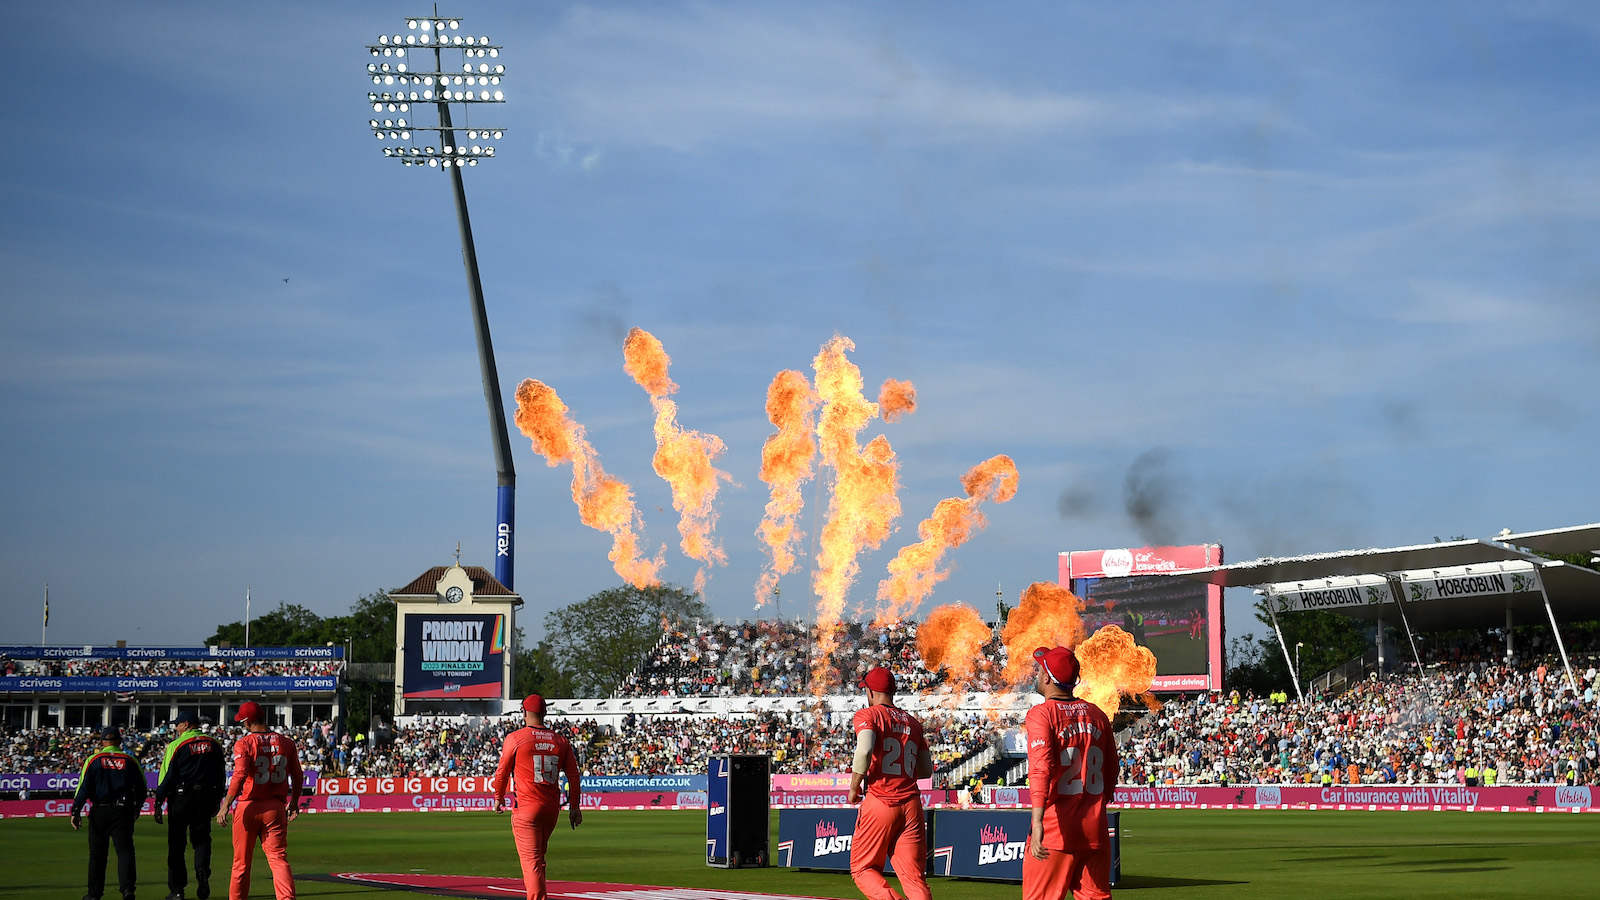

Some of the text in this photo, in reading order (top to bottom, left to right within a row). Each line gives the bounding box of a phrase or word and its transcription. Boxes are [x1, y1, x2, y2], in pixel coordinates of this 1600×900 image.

[498, 523, 510, 557] drax
[1434, 574, 1506, 597] HOBGOBLIN
[1299, 587, 1362, 608] HOBGOBLIN
[422, 621, 484, 640] PRIORITY
[44, 648, 84, 656] scrivens
[127, 648, 166, 657] scrivens
[217, 648, 255, 657] scrivens
[294, 648, 332, 657] scrivens
[422, 641, 484, 661] WINDOW
[19, 678, 62, 688] scrivens
[117, 678, 159, 688] scrivens
[202, 678, 242, 688] scrivens
[294, 678, 333, 688] scrivens
[1163, 678, 1180, 687] good
[1181, 678, 1204, 686] driving
[882, 737, 918, 778] 26
[254, 755, 288, 784] 33
[533, 755, 559, 784] 15
[1058, 746, 1104, 795] 28
[321, 779, 339, 794] IG
[349, 779, 367, 794] IG
[376, 778, 395, 793] IG
[404, 778, 422, 793] IG
[430, 778, 449, 793] IG
[457, 777, 476, 792] IG
[580, 778, 691, 787] ALLSTARSCRICKET.CO.UK
[791, 777, 834, 786] DYNAMOS
[330, 796, 357, 809] Vitality
[412, 795, 433, 807] Car
[441, 795, 511, 807] insurane
[680, 793, 705, 806] Vitality
[783, 792, 847, 804] insurance
[1130, 788, 1155, 802] with
[1156, 788, 1197, 804] Vitality
[1258, 789, 1279, 803] Vitality
[1321, 787, 1479, 806] Car insurance with Vitality
[1559, 788, 1588, 805] Vitality
[45, 800, 72, 813] Car
[816, 819, 838, 840] Vitality
[980, 824, 1007, 847] Vitality
[814, 835, 853, 857] BLAST!
[979, 842, 1026, 865] BLAST!
